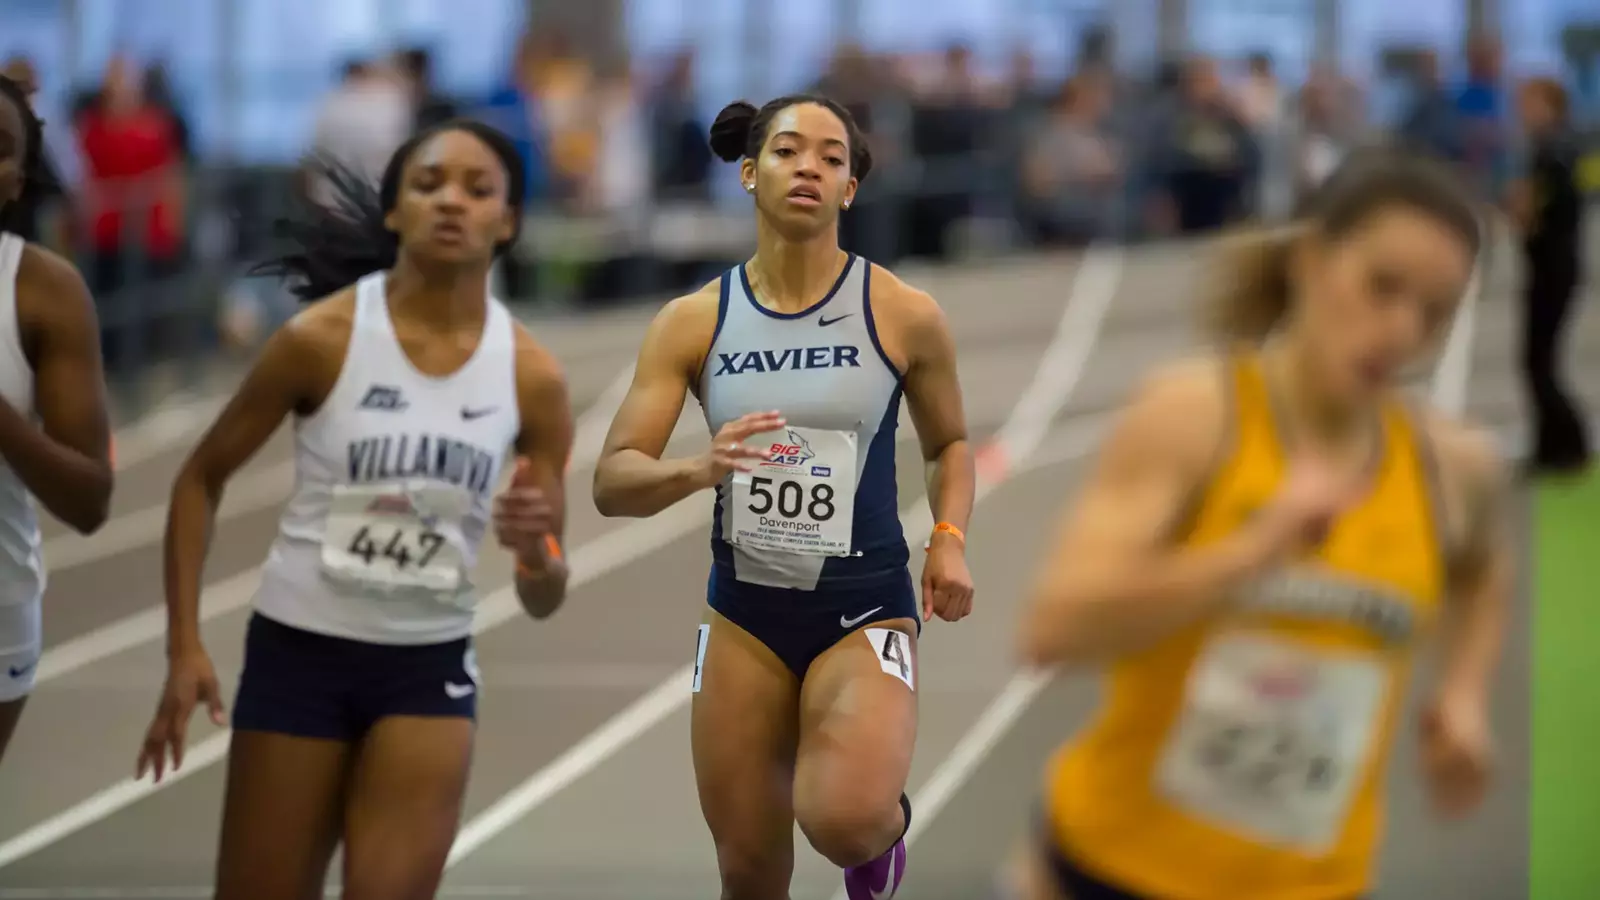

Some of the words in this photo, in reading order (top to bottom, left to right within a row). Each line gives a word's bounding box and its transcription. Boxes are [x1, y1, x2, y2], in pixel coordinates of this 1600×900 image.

[714, 345, 861, 376] XAVIER
[770, 443, 801, 455] BIG
[748, 476, 835, 521] 508
[760, 516, 820, 532] Davenport
[786, 531, 821, 539] CHAMPPS
[347, 525, 446, 568] 447
[882, 631, 909, 680] 4
